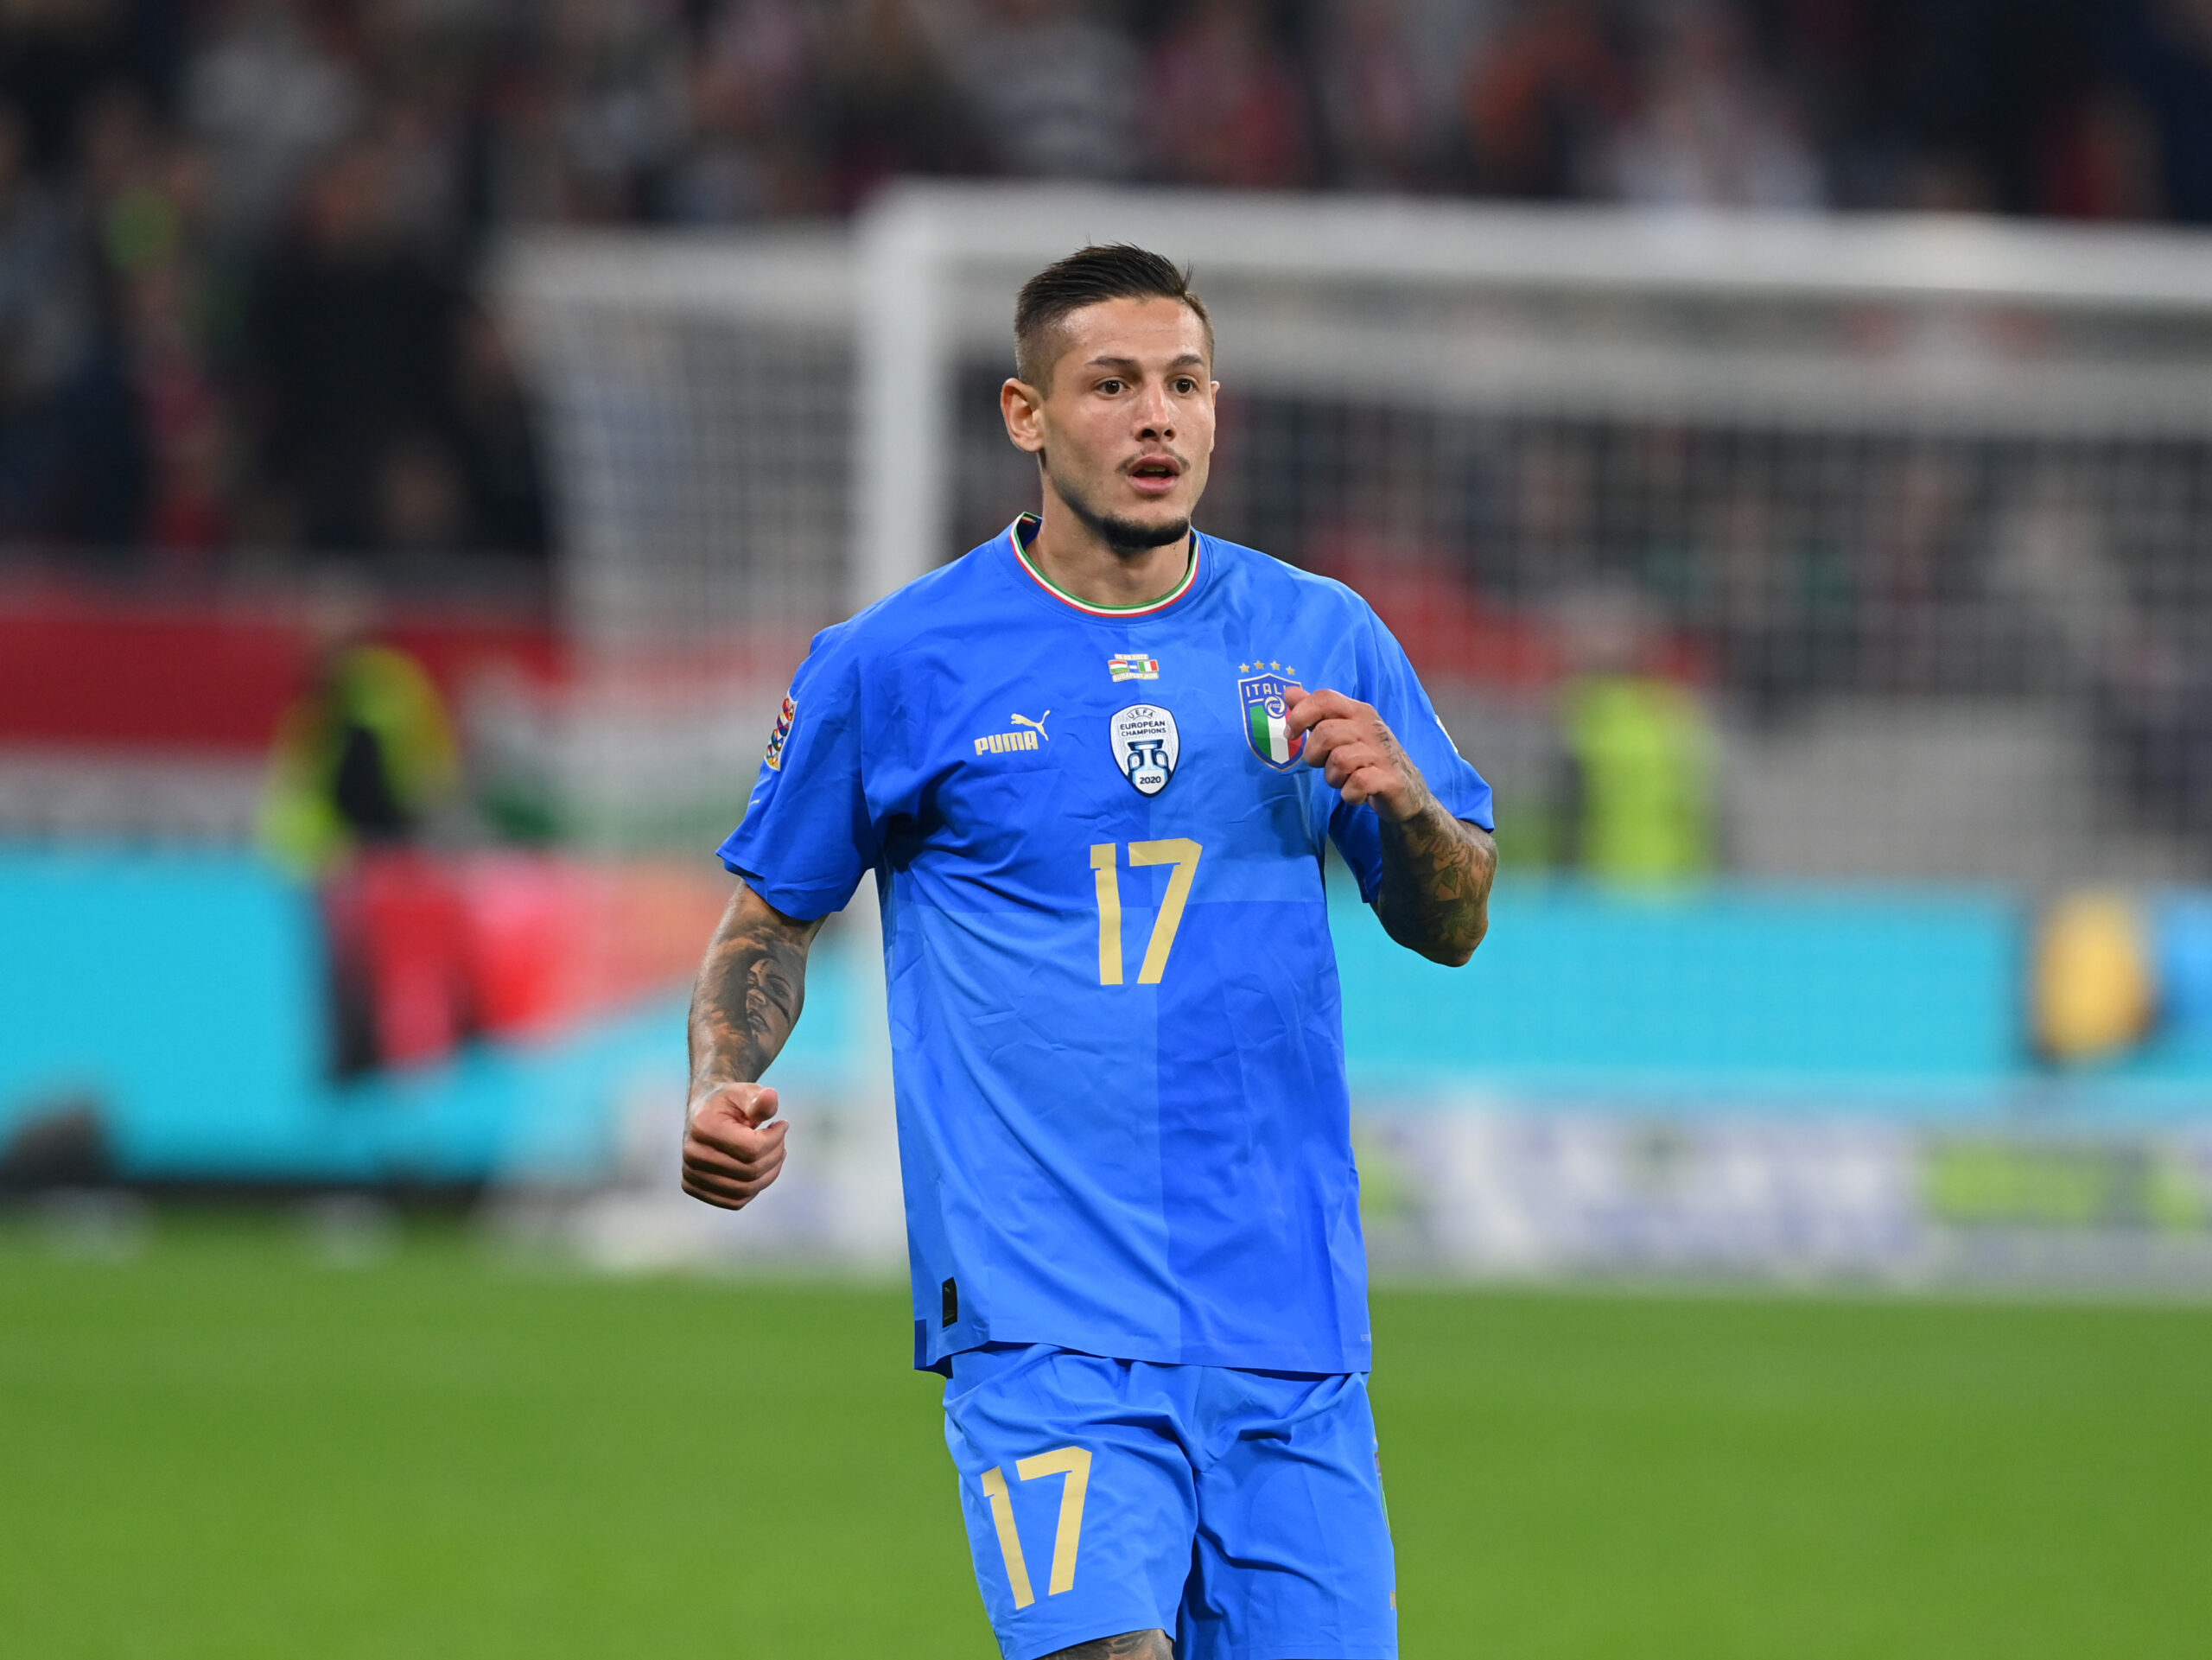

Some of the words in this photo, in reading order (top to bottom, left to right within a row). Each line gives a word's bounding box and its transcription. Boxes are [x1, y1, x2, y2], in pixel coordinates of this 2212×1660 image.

[1128, 709, 1154, 719] UEFA
[1120, 720, 1166, 730] EUROPEAN
[1121, 727, 1166, 737] CHAMPIONS
[974, 730, 1039, 756] PUMA
[1139, 775, 1161, 785] 2020
[1090, 837, 1204, 986] 17
[980, 1445, 1093, 1611] 17
